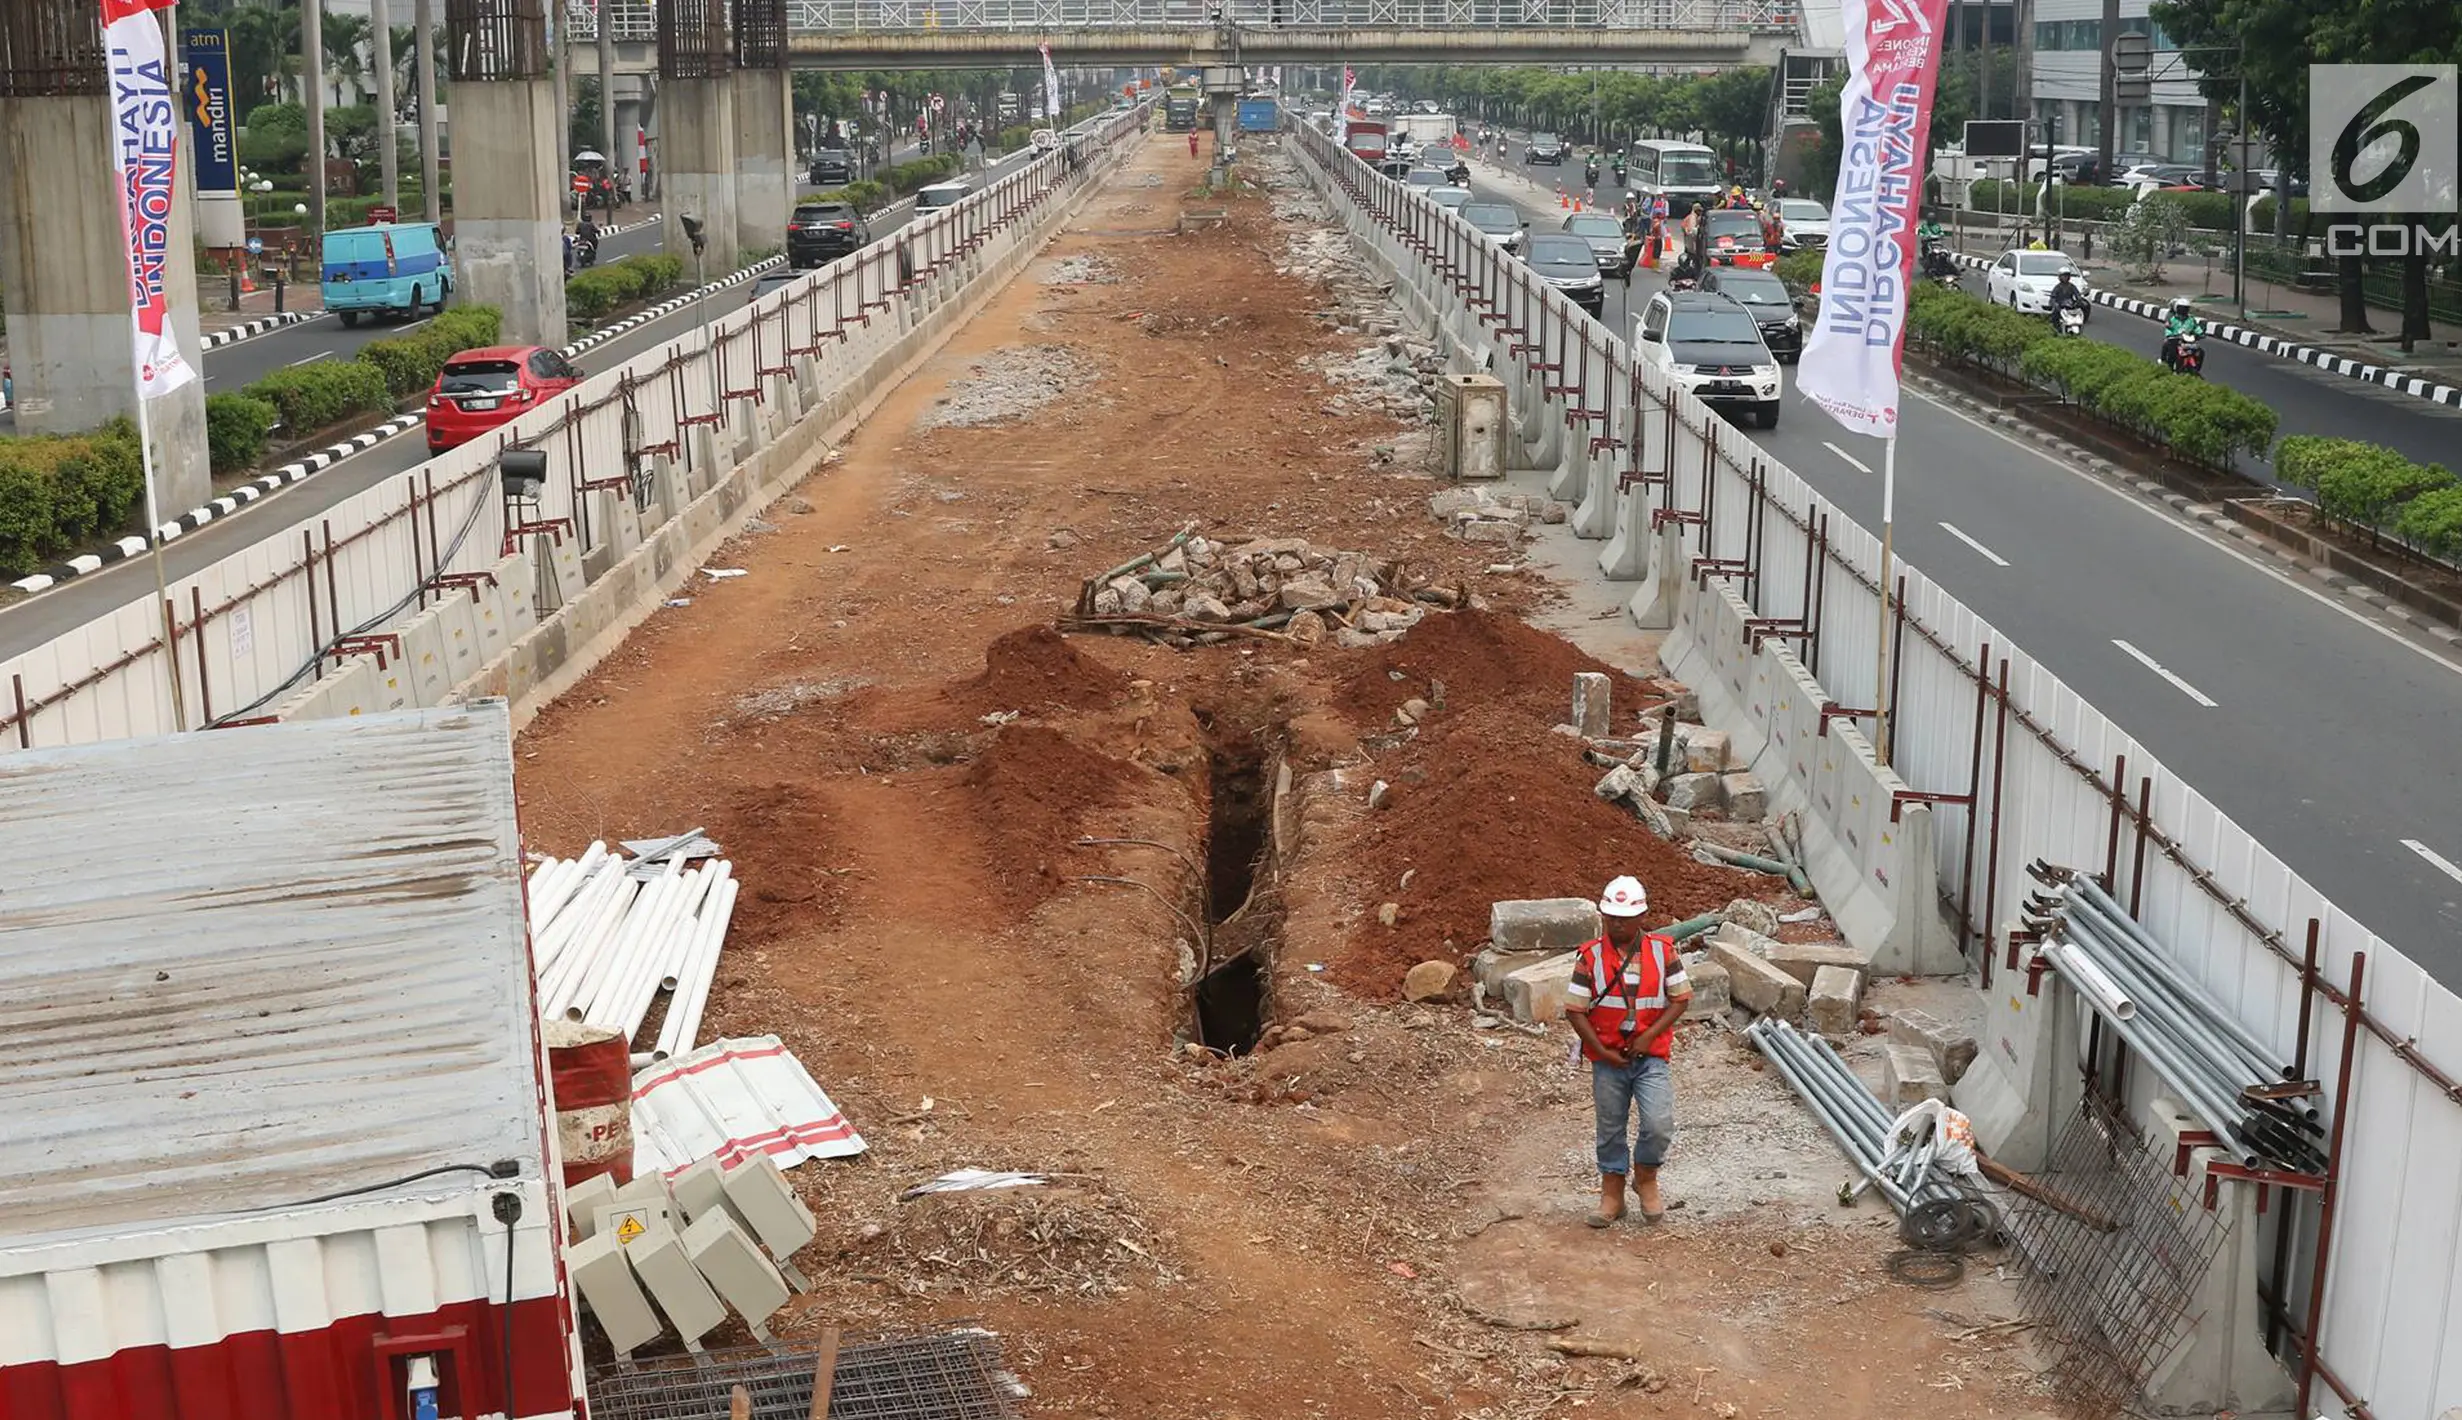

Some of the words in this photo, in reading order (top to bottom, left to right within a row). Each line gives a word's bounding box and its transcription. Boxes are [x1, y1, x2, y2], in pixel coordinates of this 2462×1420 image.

[191, 34, 219, 46] atm
[207, 88, 228, 162] mandiri
[137, 59, 172, 294] INDONESIA
